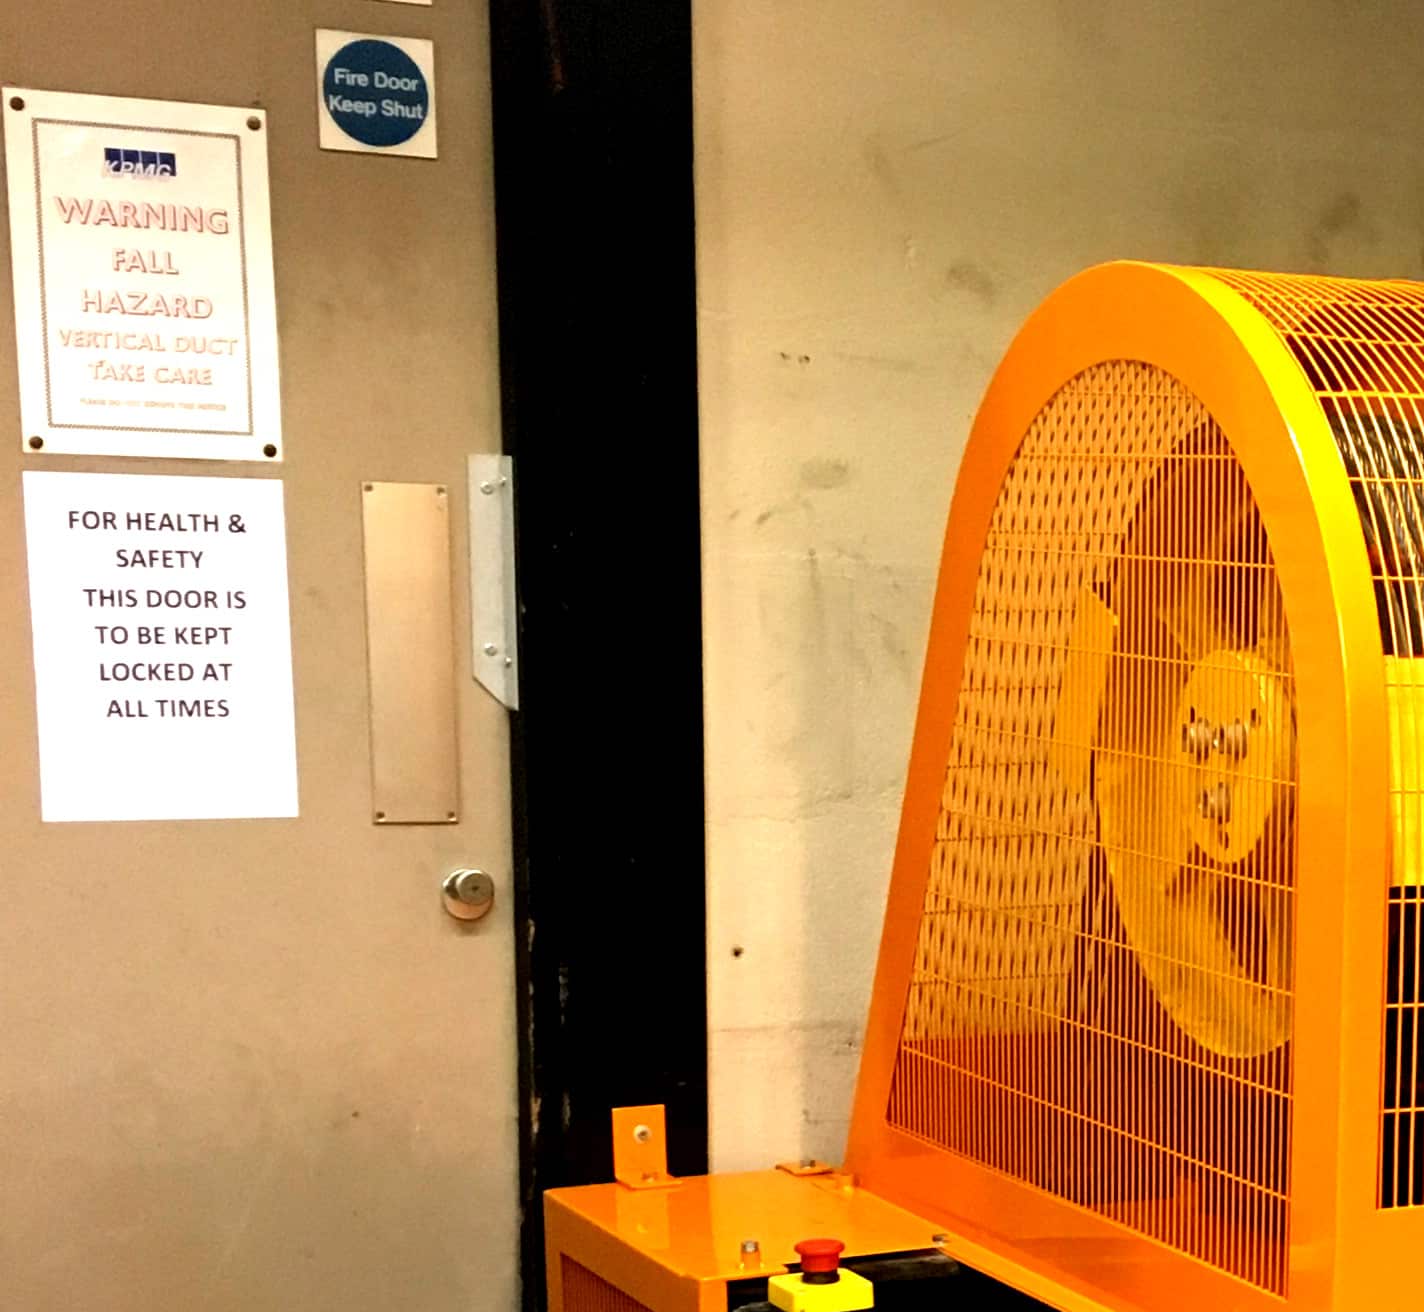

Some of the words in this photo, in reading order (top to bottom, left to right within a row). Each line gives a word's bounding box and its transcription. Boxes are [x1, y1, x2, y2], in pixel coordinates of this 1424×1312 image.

[334, 67, 369, 87] Fire
[374, 71, 418, 92] Door
[328, 94, 377, 118] Keep
[381, 98, 424, 119] Shut
[103, 159, 173, 178] KPMG
[54, 196, 229, 235] WARNING
[112, 248, 179, 276] FALL
[82, 288, 213, 319] HAZARD
[59, 329, 166, 352] VERTICAL
[174, 335, 238, 356] DUCT
[88, 359, 145, 383] TAKE
[154, 366, 213, 386] CARE
[68, 511, 117, 530] FOR
[126, 512, 219, 533] HEALTH
[228, 514, 246, 534] &
[116, 549, 203, 568] SAFETY
[83, 588, 138, 608] THIS
[146, 589, 218, 609] DOOR
[226, 590, 247, 609] IS
[95, 625, 129, 645] TO
[137, 626, 166, 645] BE
[175, 627, 232, 645] KEPT
[100, 662, 194, 682] LOCKED
[202, 663, 232, 682] AT
[107, 699, 148, 718] ALL
[155, 699, 230, 718] TIMES
